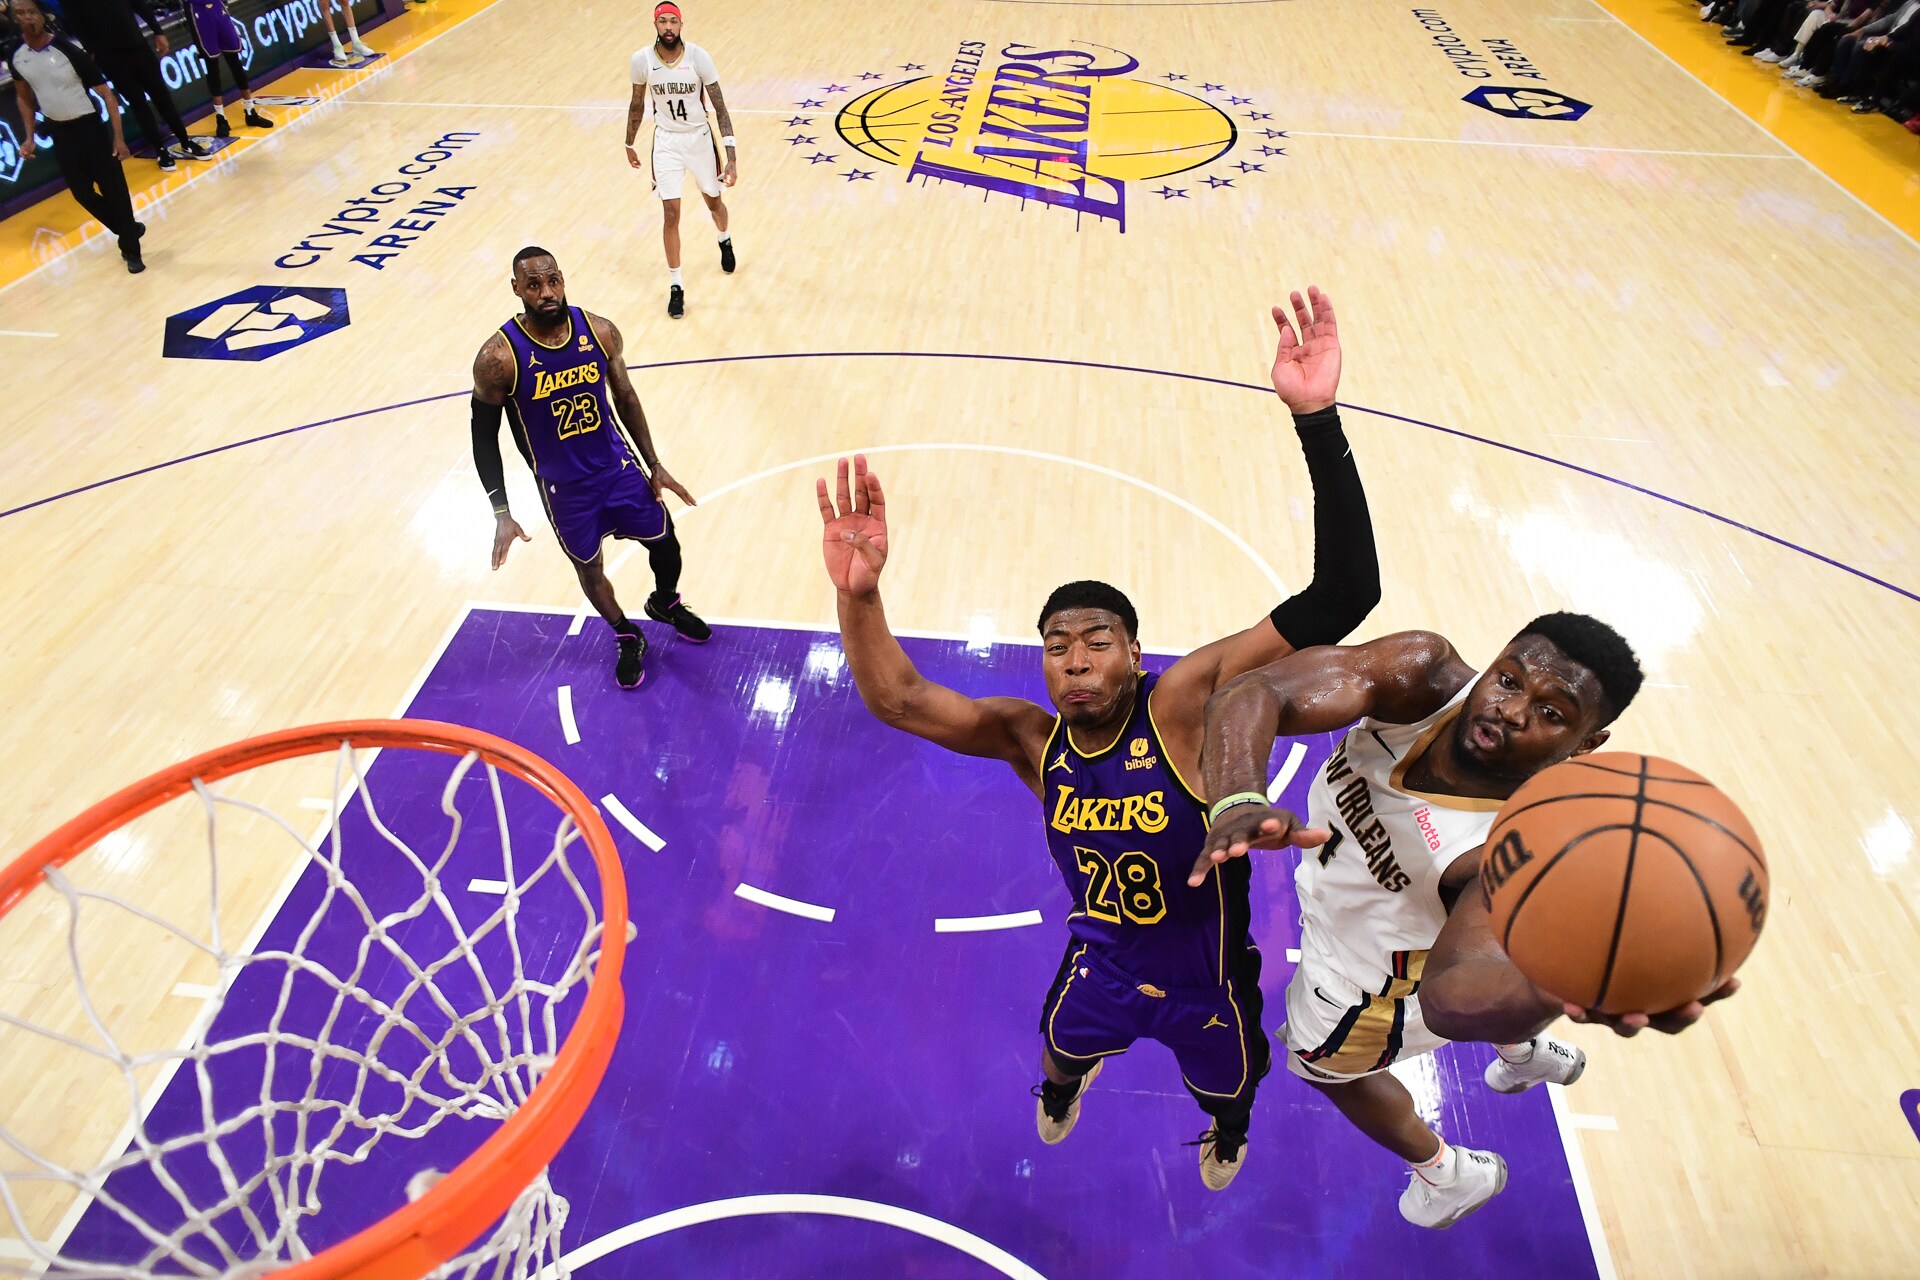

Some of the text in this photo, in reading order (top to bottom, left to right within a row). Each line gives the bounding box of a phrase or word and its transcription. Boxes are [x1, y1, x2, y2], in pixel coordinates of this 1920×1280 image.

[1411, 8, 1492, 79] crypto.com
[1481, 38, 1548, 81] ARENA
[666, 99, 688, 121] 14
[667, 82, 697, 95] ORLEANS
[923, 40, 986, 148] LOS ANGELES
[906, 39, 1140, 234] LAKERS
[274, 132, 481, 269] crypto.com
[348, 185, 478, 271] ARENA
[531, 361, 601, 401] LAKERS
[550, 392, 602, 441] 23
[1124, 755, 1157, 771] bibigo
[1050, 784, 1169, 835] LAKERS
[1335, 776, 1412, 893] ORLEANS
[1414, 807, 1441, 852] ibotta
[1073, 845, 1167, 925] 28
